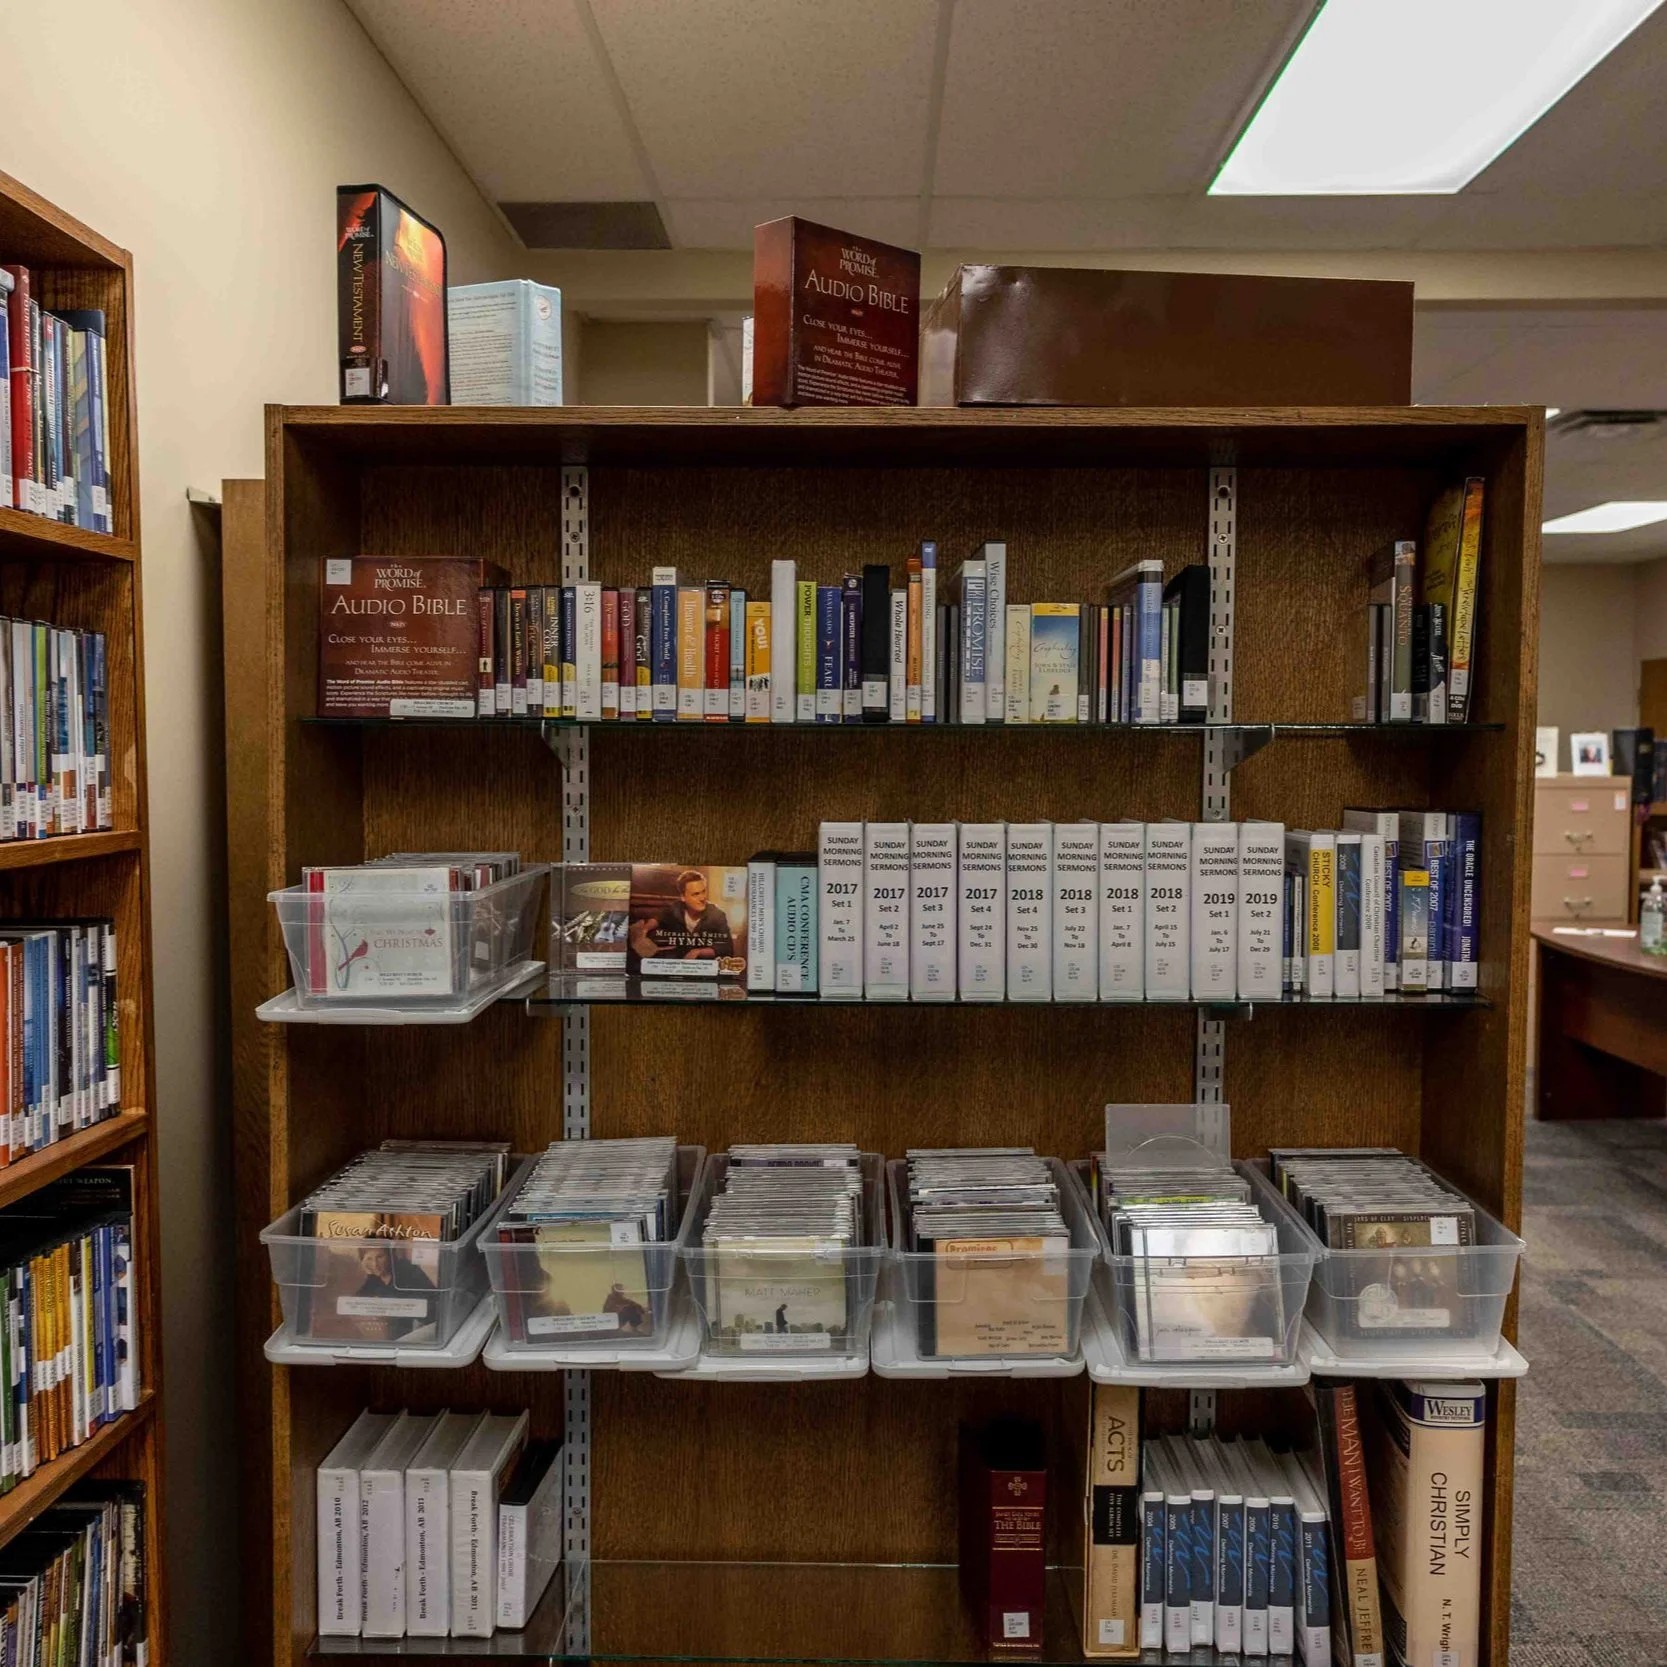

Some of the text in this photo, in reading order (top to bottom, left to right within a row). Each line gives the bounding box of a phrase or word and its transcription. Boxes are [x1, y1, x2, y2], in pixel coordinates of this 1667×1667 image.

[842, 248, 870, 263] WORD
[840, 259, 877, 277] PROMISE
[353, 243, 365, 342] NEW TESTAMENT
[805, 269, 909, 314] AUDIO BIBLE
[376, 568, 413, 578] WORD
[990, 561, 1000, 587] Wise
[375, 579, 423, 591] PROMISE
[331, 595, 467, 615] AUDIO BIBLE
[804, 585, 812, 617] POWER
[1398, 585, 1411, 646] SQUANTO
[328, 634, 356, 644] CLOSE
[550, 616, 559, 647] INNER
[894, 601, 903, 664] Whole Hearted
[972, 602, 985, 677] PROMISE
[371, 645, 410, 654] IMMERSE
[544, 630, 552, 656] CORE
[823, 848, 862, 856] MORNING
[912, 851, 952, 859] MORNING
[1008, 853, 1047, 861] MORNING
[1058, 853, 1097, 861] MORNING
[1312, 852, 1320, 886] CHURCH
[1322, 852, 1331, 888] STICKY
[826, 883, 858, 894] 2017
[874, 888, 905, 899] 2017
[917, 887, 948, 898] 2017
[1107, 888, 1139, 899] 2018
[1151, 888, 1183, 899] 2018
[1430, 860, 1439, 912] BEST OF 2007
[1462, 840, 1475, 927] THE ORACLE UNCENSORED!
[966, 889, 997, 899] 2017
[1012, 889, 1043, 900] 2018
[1060, 889, 1092, 900] 2018
[1204, 894, 1235, 904] 2019
[1246, 894, 1277, 904] 2019
[787, 896, 797, 961] AUDIO CD'S
[800, 875, 810, 981] CMA CONFERENCE
[374, 937, 444, 949] CHRISTMAS
[669, 937, 714, 947] HYMNS
[328, 1221, 432, 1238] Susan Ashton
[1428, 1400, 1472, 1417] WESLEY
[1107, 1416, 1126, 1473] ACTS
[1343, 1417, 1362, 1466] MAN
[1349, 1475, 1366, 1516] WANT
[334, 1518, 341, 1528] AB
[471, 1514, 479, 1534] Forth
[996, 1521, 1015, 1531] THE
[1430, 1472, 1448, 1576] CHRISTIAN
[1455, 1490, 1472, 1559] SIMPLY
[335, 1529, 343, 1569] Edmonton,
[471, 1539, 479, 1578] Edmonton,
[335, 1576, 344, 1597] Forth
[471, 1580, 479, 1592] AB
[336, 1598, 344, 1620] Break
[1356, 1568, 1373, 1655] NEAL JEFFRE
[1440, 1598, 1452, 1654] N. T. Wrigh
